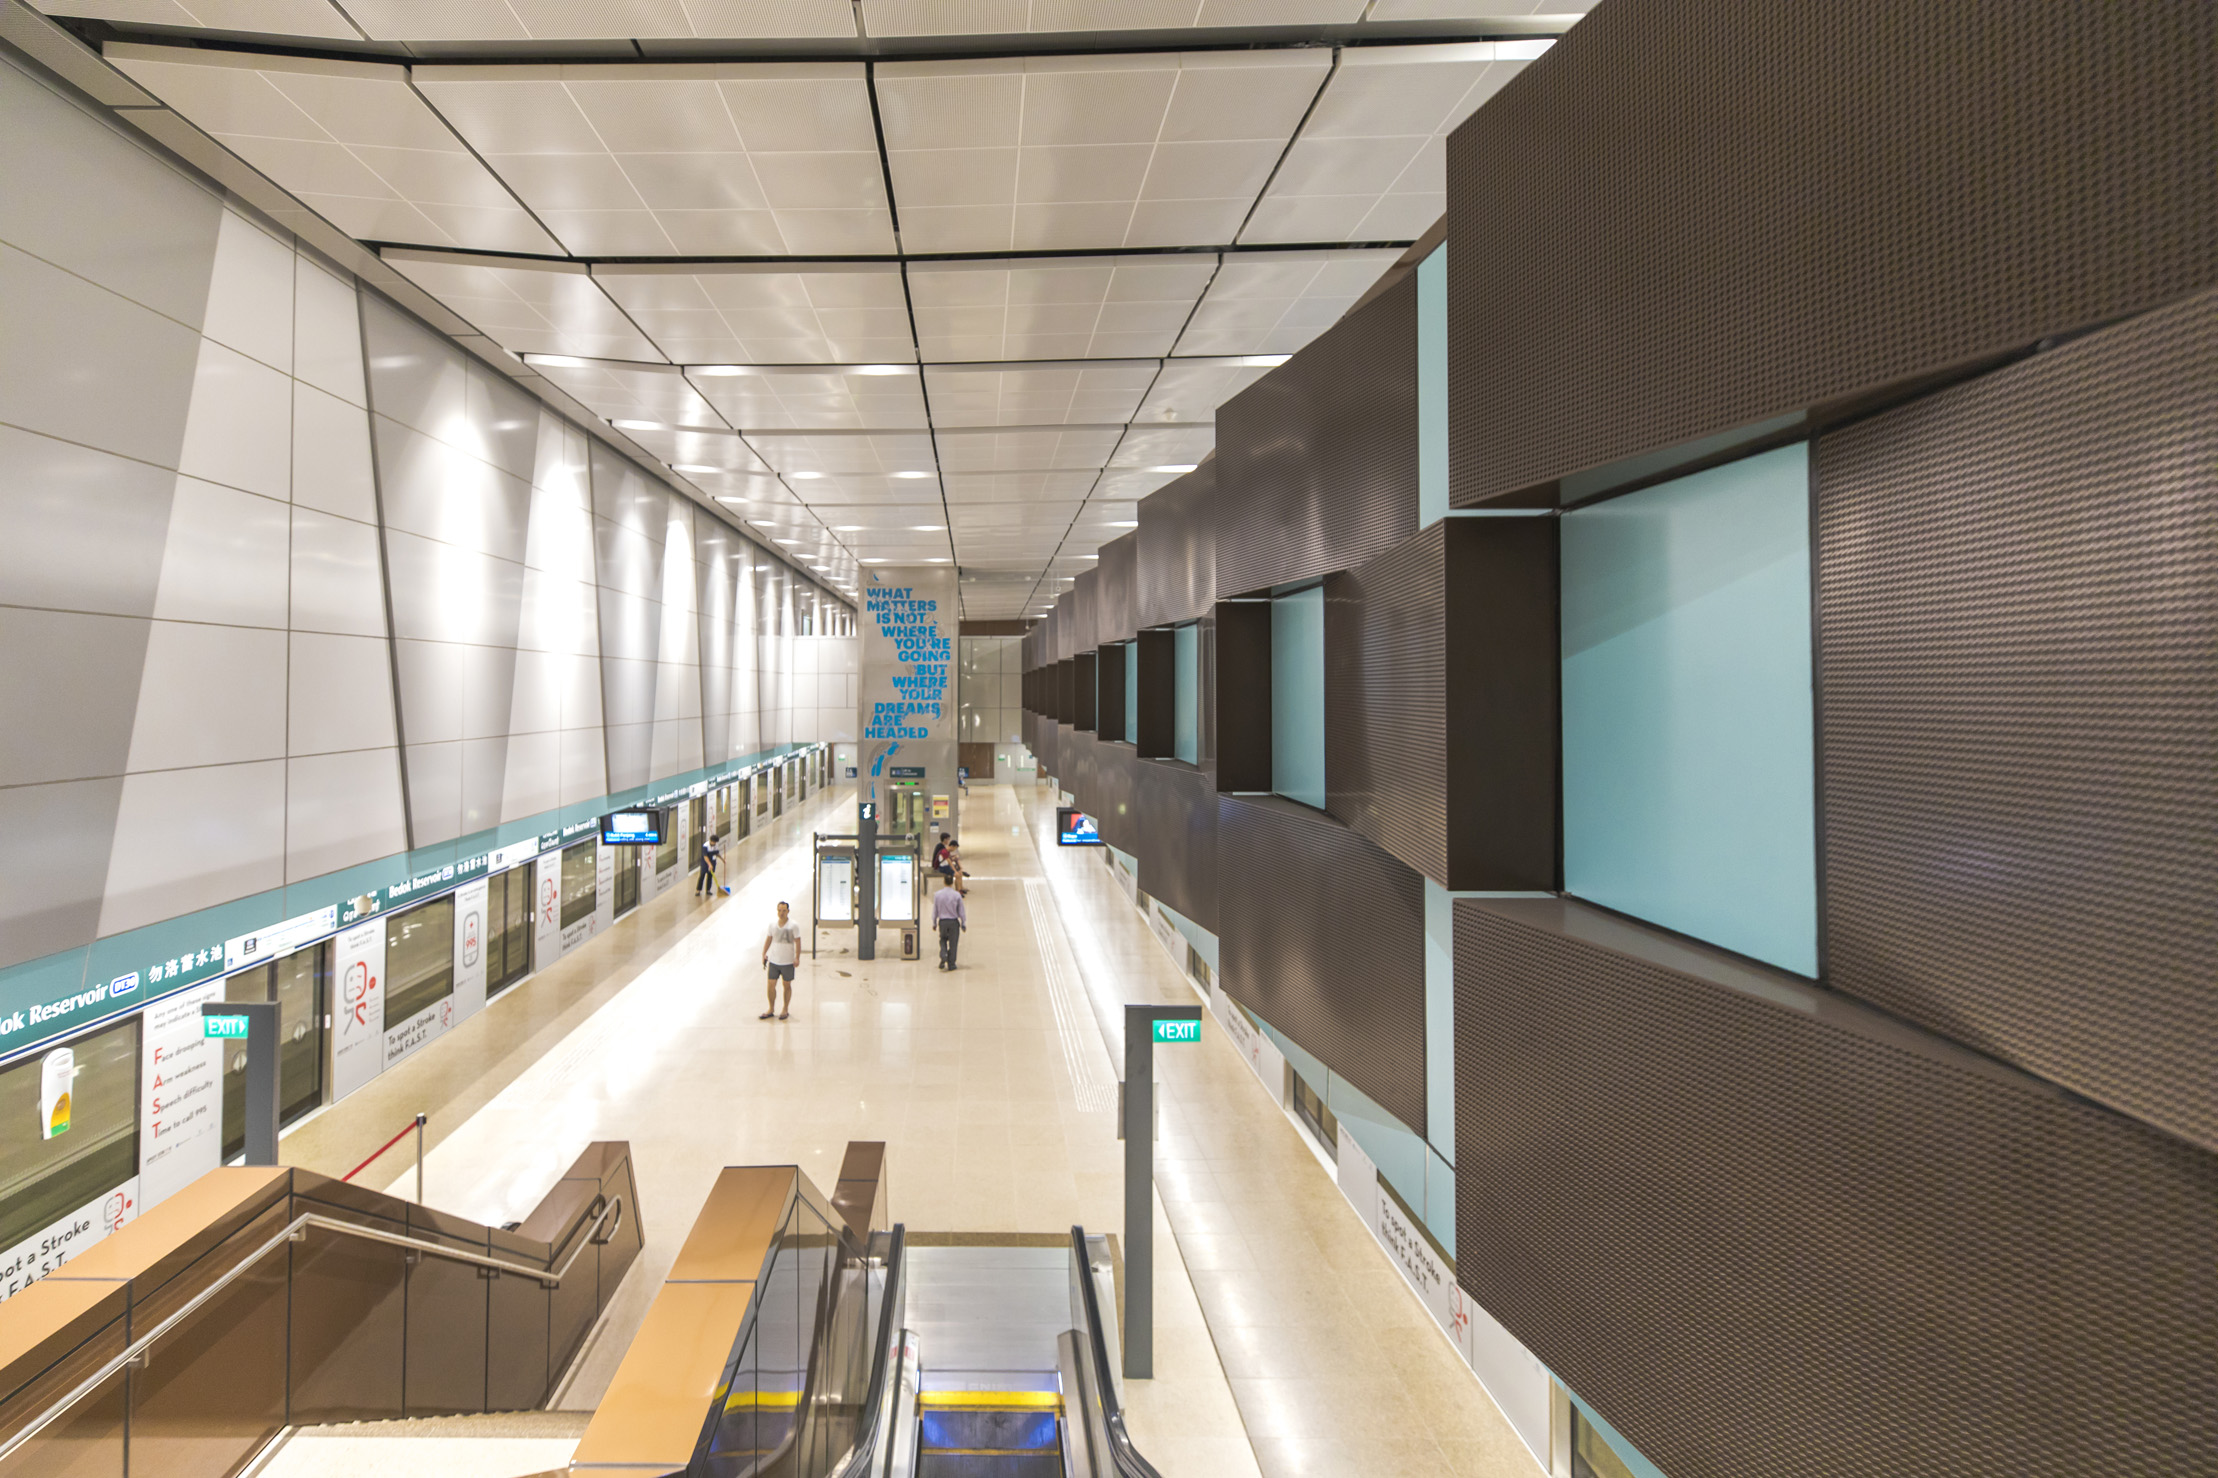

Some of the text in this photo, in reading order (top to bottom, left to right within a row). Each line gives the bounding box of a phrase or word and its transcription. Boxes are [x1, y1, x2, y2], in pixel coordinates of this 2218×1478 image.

[867, 588, 913, 599] WHAT
[867, 600, 937, 612] MATTERS
[876, 613, 926, 624] IS NOT
[882, 626, 937, 637] WHERE
[898, 650, 951, 662] GOING
[915, 664, 947, 676] BUT
[892, 676, 947, 688] WHERE
[900, 689, 942, 700] YOUR
[875, 702, 940, 714] DREAMS
[872, 715, 903, 726] ARE
[865, 727, 928, 739] HEADED
[389, 880, 411, 898] Bedok
[412, 869, 442, 890] Reservoir
[0, 1011, 26, 1036] ok
[29, 983, 109, 1026] Reservoir
[208, 1018, 239, 1035] EXIT
[389, 1034, 396, 1046] To
[397, 1025, 411, 1042] spot
[416, 1012, 436, 1029] Stroke
[1166, 1022, 1197, 1039] EXIT
[154, 1038, 205, 1065] Face drooping
[388, 1043, 404, 1061] think
[153, 1061, 206, 1091] Arm weakness
[152, 1096, 182, 1115] Speech
[152, 1120, 172, 1139] Time
[173, 1120, 181, 1129] to
[182, 1111, 194, 1124] call
[26, 1252, 37, 1265] a
[40, 1219, 91, 1256] Stroke
[1414, 1241, 1441, 1285] Stroke
